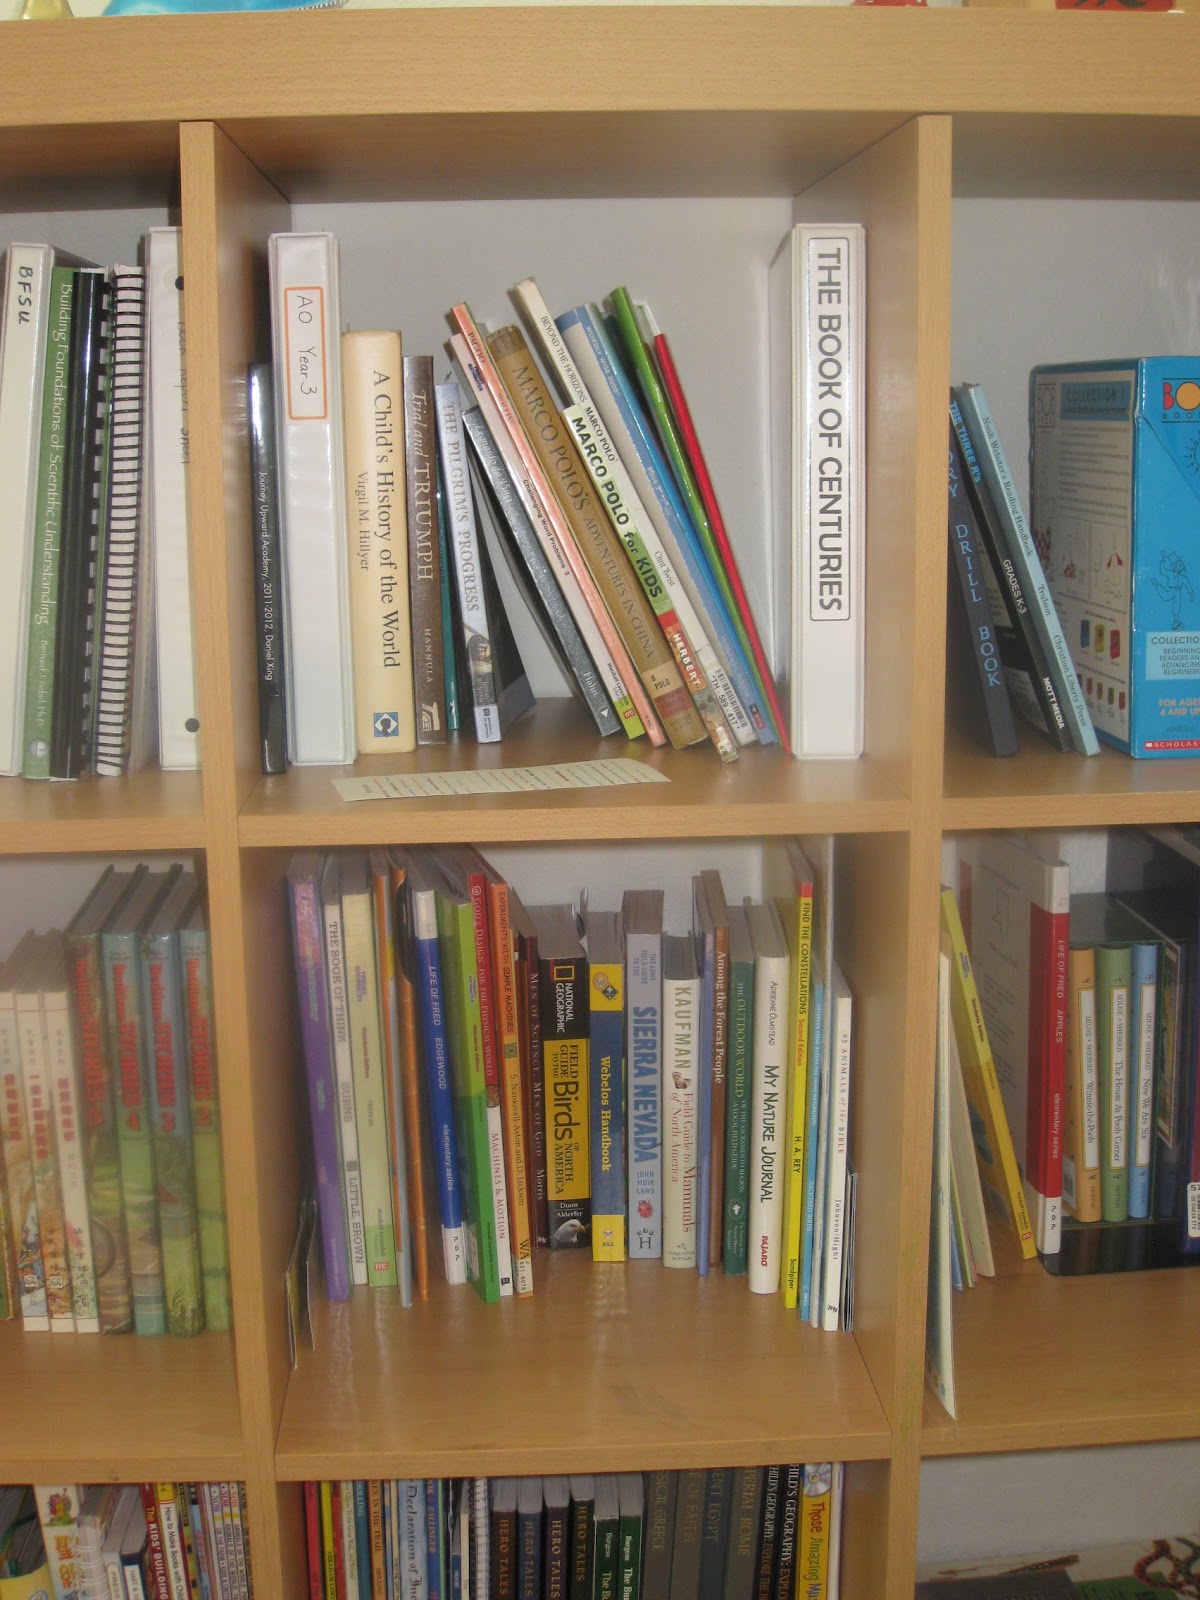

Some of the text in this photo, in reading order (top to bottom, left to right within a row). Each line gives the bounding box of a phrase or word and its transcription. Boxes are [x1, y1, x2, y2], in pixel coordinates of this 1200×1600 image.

[18, 266, 34, 324] BFSU
[298, 346, 318, 379] Year
[300, 384, 318, 395] 3
[540, 315, 561, 347] BEYOND
[557, 346, 570, 365] THE
[564, 360, 588, 403] HORIZONS
[584, 406, 605, 438] MARCO
[34, 284, 73, 625] Building Foundations of Scientific Understanding
[818, 247, 843, 611] THE BOOK OF CENTURIES
[957, 426, 977, 464] THREE
[373, 370, 401, 668] A Child's History of the World
[411, 389, 434, 581] Trial and TRIUMPH
[443, 401, 480, 612] THE PILGRIM'S PROGRESS
[512, 366, 655, 659] MARCO POLO'S ADVENTURES CHINA
[571, 416, 663, 598] MARCO POLO for KIDS
[990, 441, 1034, 558] Webster's Reading Handbook
[357, 471, 371, 572] Virgil M. Hillyer
[523, 479, 566, 570] Challenging Word Problems
[258, 471, 274, 664] Journey Upward Academy, 2011-2012, Daniel
[1003, 559, 1022, 599] GRADES
[1037, 584, 1051, 617] Trulson
[955, 523, 1002, 688] DRILL BOOK
[424, 628, 434, 684] HANNULA
[583, 670, 599, 698] Hahn
[655, 678, 671, 690] POLO
[672, 633, 701, 686] HERBERT
[1053, 634, 1087, 728] Christian Liberty Press
[1042, 677, 1066, 730] MOTT MEDIA
[328, 921, 347, 1043] THE BOOK THINK
[498, 891, 514, 1033] EXPERIMENTS SIMPLE MACHINES
[799, 902, 811, 1015] FIND CONSTELLATIONS
[482, 1004, 491, 1042] PHYSICAL
[556, 982, 565, 1033] GEOGRAPHIC
[564, 981, 574, 1022] NATIONAL
[674, 986, 692, 1069] KAUFMAN
[714, 950, 727, 1085] Among Forest People
[1055, 974, 1065, 1043] FRED APPLES
[432, 1000, 447, 1090] FRED EDGEWOOD
[560, 1044, 569, 1079] GUIDE
[569, 1044, 579, 1078] FIELD
[735, 999, 746, 1098] OUTDOOR WORLD
[840, 1048, 849, 1094] ANIMALS
[341, 1081, 353, 1123] BURNS
[553, 1081, 581, 1140] Birds
[600, 1056, 612, 1172] Webelos Handbook
[633, 1006, 658, 1164] SIERRA NEVADA
[1085, 1081, 1094, 1144] Winnie-the-Pooh
[441, 1124, 452, 1166] elementary
[554, 1143, 565, 1195] AMERICA
[564, 1143, 574, 1183] NORTH
[671, 1107, 682, 1184] North America
[683, 1092, 696, 1233] Field Mammals
[760, 1065, 779, 1203] MY NATURE JOURNAL
[491, 1133, 506, 1239] MACHINES MOTION
[555, 1210, 584, 1218] Alderfer
[636, 1187, 655, 1195] LAWS
[637, 1179, 655, 1187] MUIR
[347, 1176, 364, 1264] LITTLE BROWN
[832, 1199, 842, 1260] Johnson/Hight
[789, 1258, 797, 1290] Sandpiper
[165, 1506, 179, 1568] How Make Books
[406, 1484, 418, 1560] Declaration
[576, 1506, 587, 1582] HERO TALES
[706, 1502, 721, 1542] EGYPT
[763, 1493, 777, 1543] GEOGRAPHY:
[781, 1500, 796, 1566] GEOGRAPHY:
[804, 1501, 826, 1581] Those Amazing
[149, 1522, 168, 1600] KIDS' BUILDING
[500, 1519, 509, 1595] HERO TALES
[524, 1521, 534, 1597] HERO TALES
[551, 1520, 562, 1598] HERO TALES
[602, 1532, 613, 1589] Burgess The
[623, 1535, 633, 1584] Burgess The
